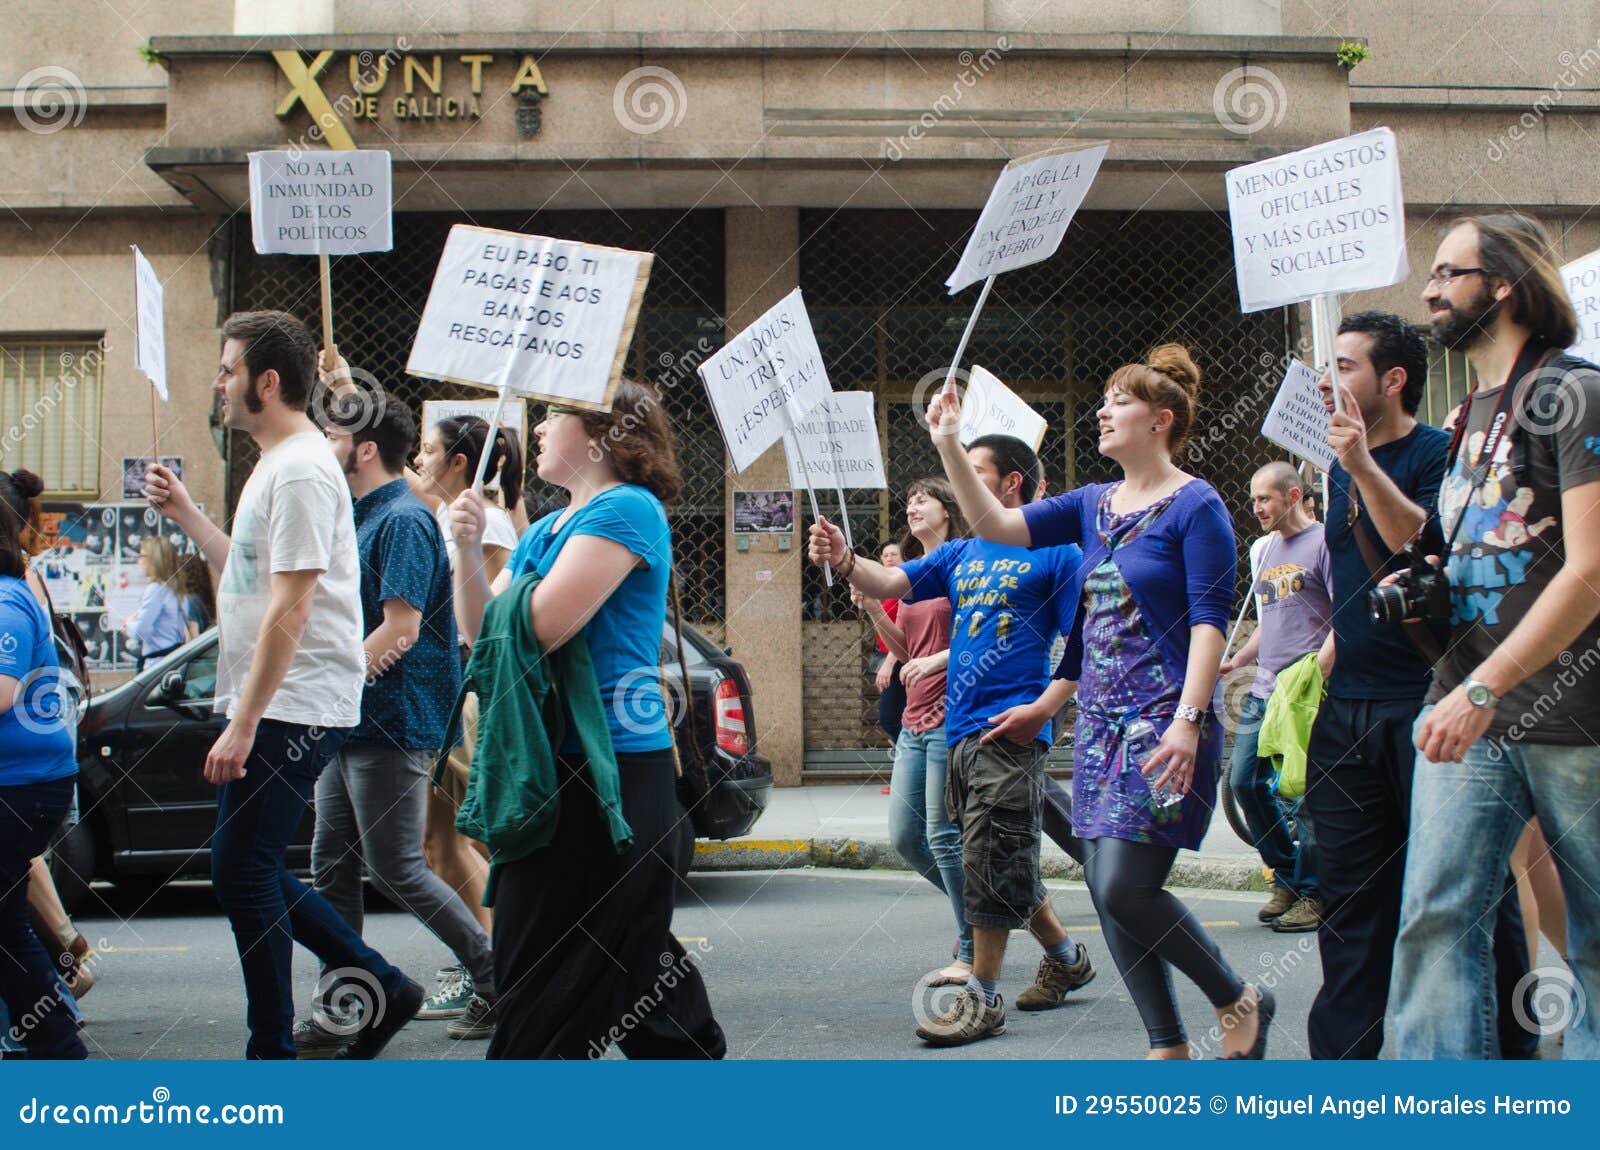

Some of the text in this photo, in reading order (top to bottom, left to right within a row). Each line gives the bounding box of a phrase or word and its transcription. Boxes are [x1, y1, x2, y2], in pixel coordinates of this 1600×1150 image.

[270, 50, 550, 149] XUNTA
[352, 97, 482, 119] DE GALICIA
[285, 161, 355, 176] NO A LA
[1061, 163, 1081, 182] LA
[1235, 141, 1387, 199] MENOS GASTOS
[269, 183, 374, 198] INMUNIDAD
[1260, 178, 1363, 220] OFICIALES
[292, 204, 352, 218] DE LOS
[977, 212, 1049, 249] ENCENDE
[1245, 204, 1390, 254] Y MÁS GASTOS
[482, 244, 512, 263] EU
[580, 258, 600, 276] TI
[1270, 240, 1366, 277] SOCIALES
[463, 269, 603, 306] PAGAS E AOS
[482, 300, 567, 330] BANCOS
[448, 322, 586, 361] RESCATANOS
[991, 404, 1016, 431] STOP
[1483, 411, 1507, 453] Canon
[968, 560, 985, 574] SE
[991, 559, 1031, 574] ISTO
[956, 574, 1019, 592] NON SE
